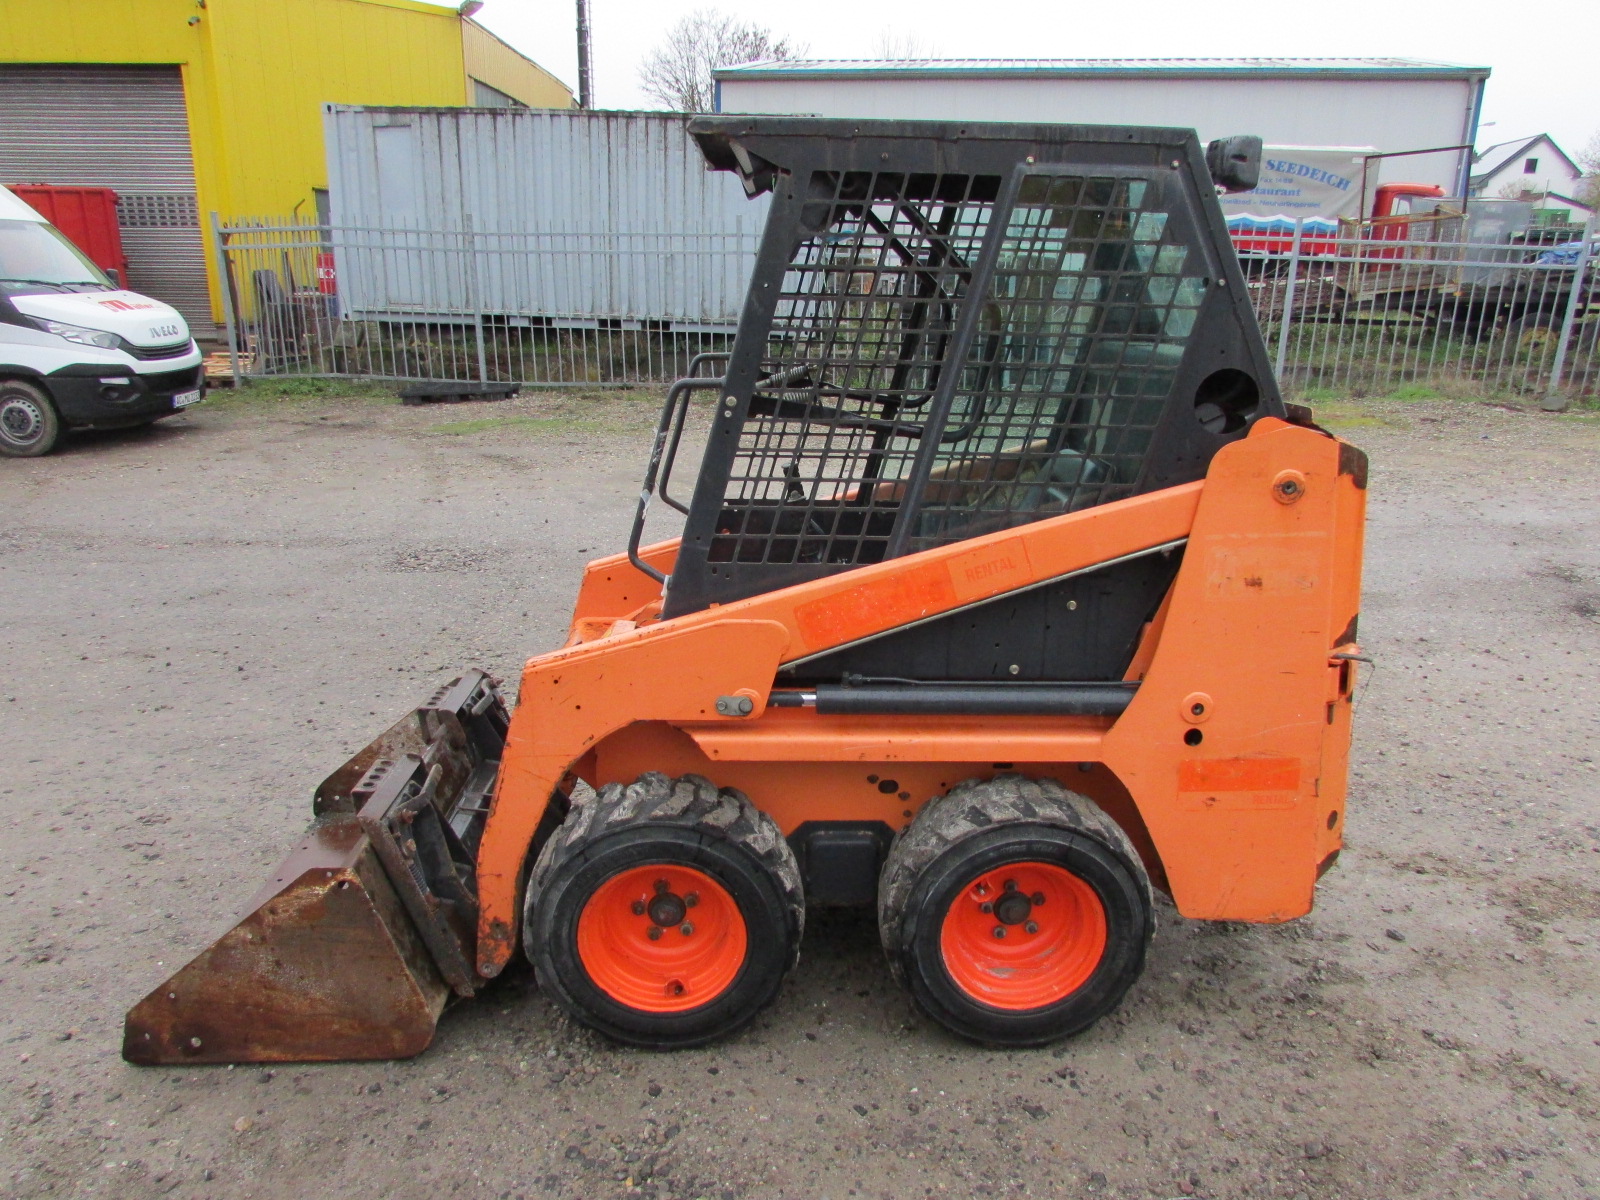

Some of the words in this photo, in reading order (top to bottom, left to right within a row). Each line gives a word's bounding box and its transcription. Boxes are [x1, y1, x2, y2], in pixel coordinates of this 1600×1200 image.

[1265, 159, 1351, 191] SEEDEICH
[1243, 187, 1301, 196] staurant
[149, 325, 179, 338] IVECO
[964, 556, 1017, 582] RENTAL
